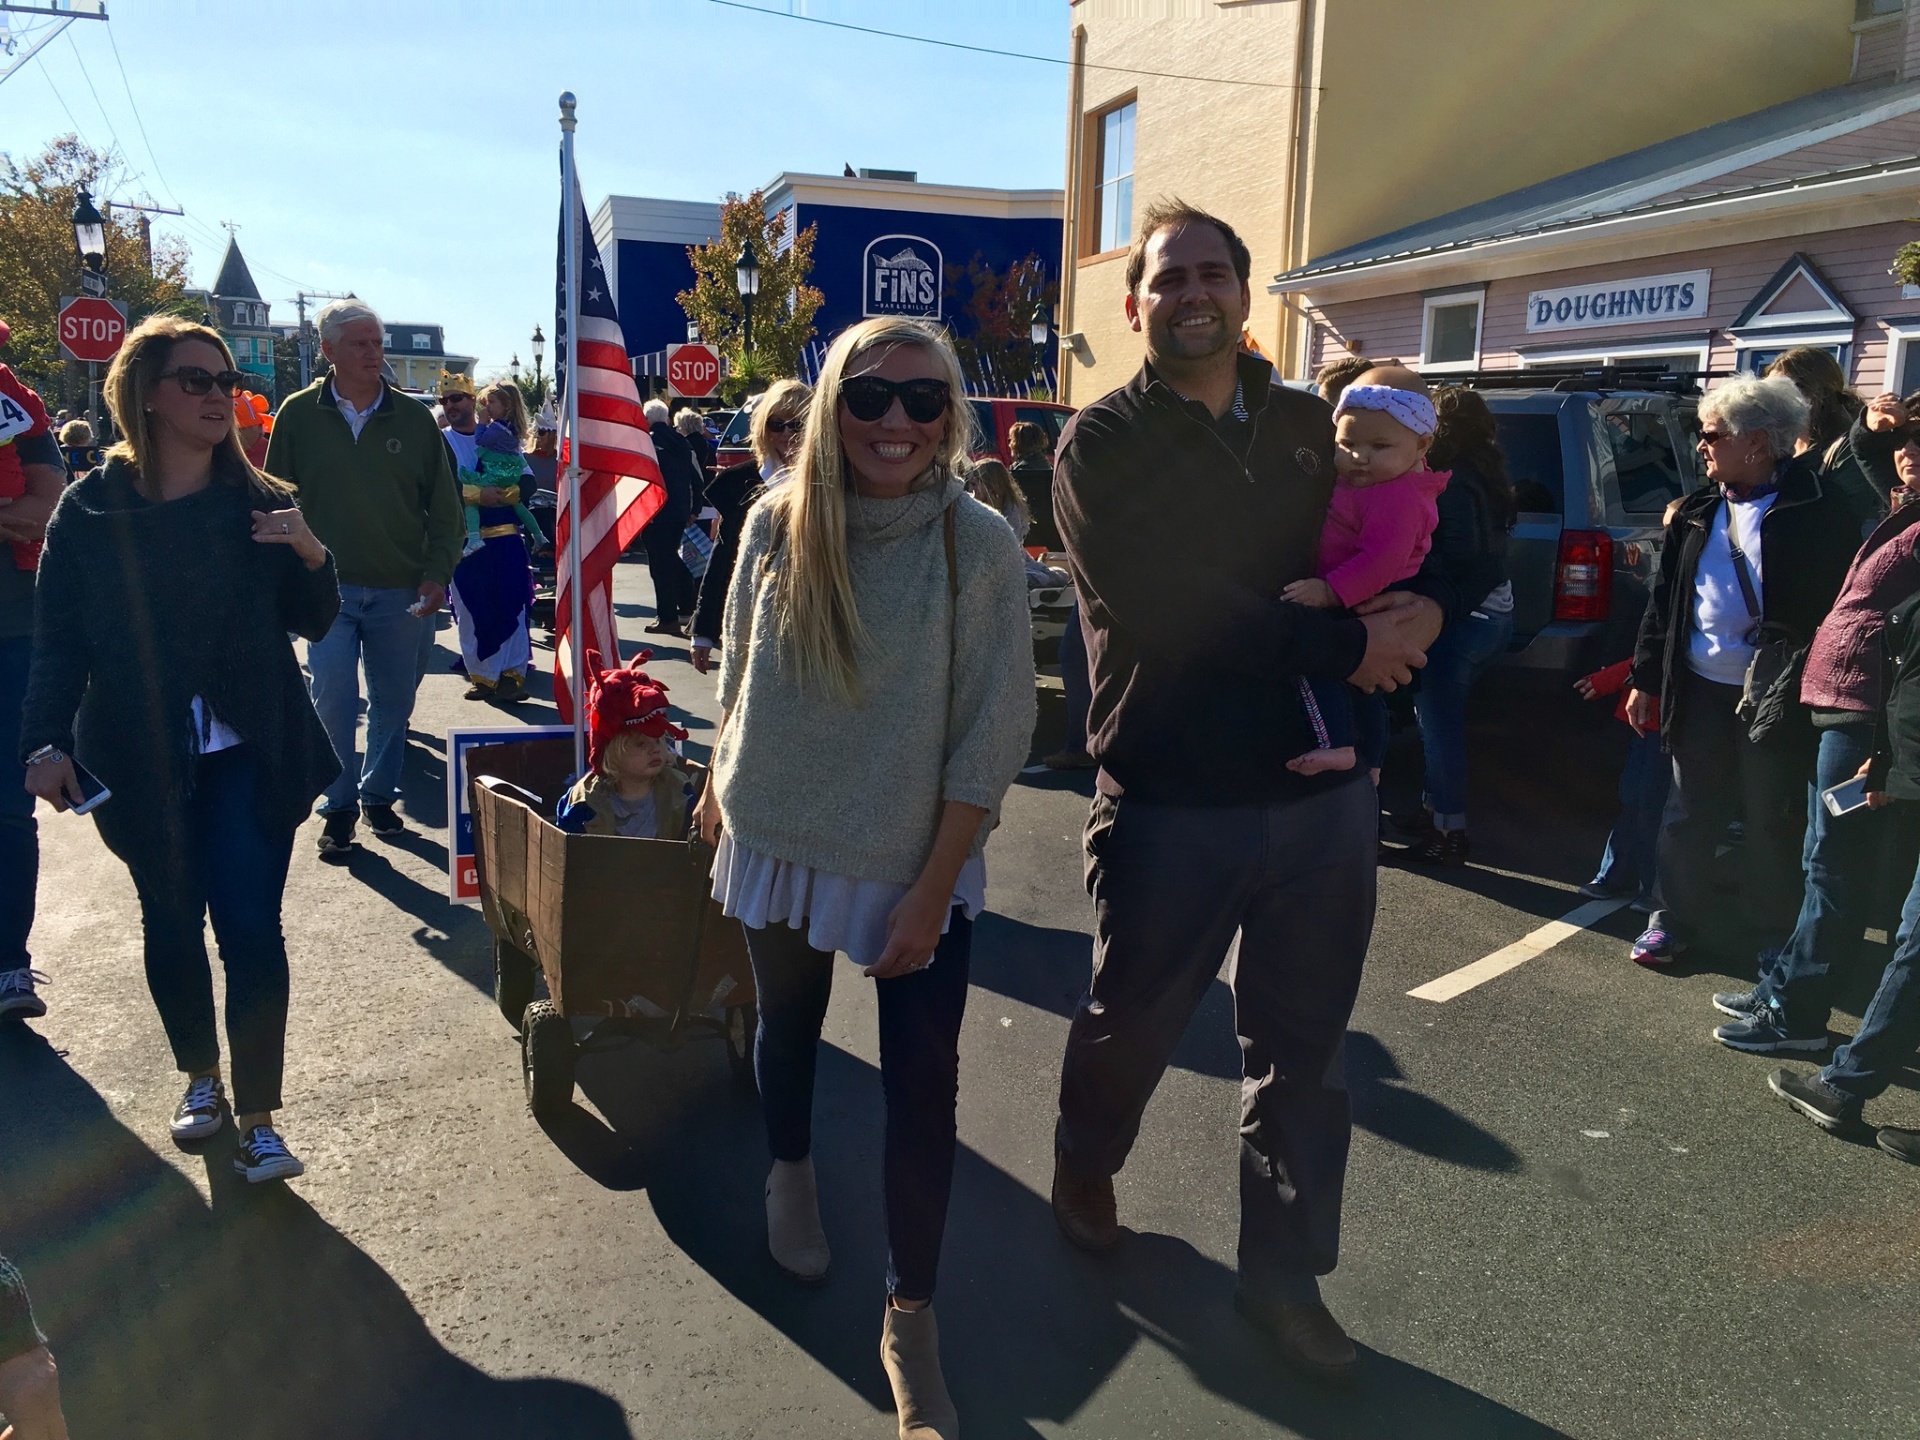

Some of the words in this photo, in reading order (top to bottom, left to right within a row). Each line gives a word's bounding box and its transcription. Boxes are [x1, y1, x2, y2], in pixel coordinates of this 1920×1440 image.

[1535, 282, 1695, 326] DOUGHNUTS
[63, 316, 122, 342] STOP
[671, 360, 717, 381] STOP
